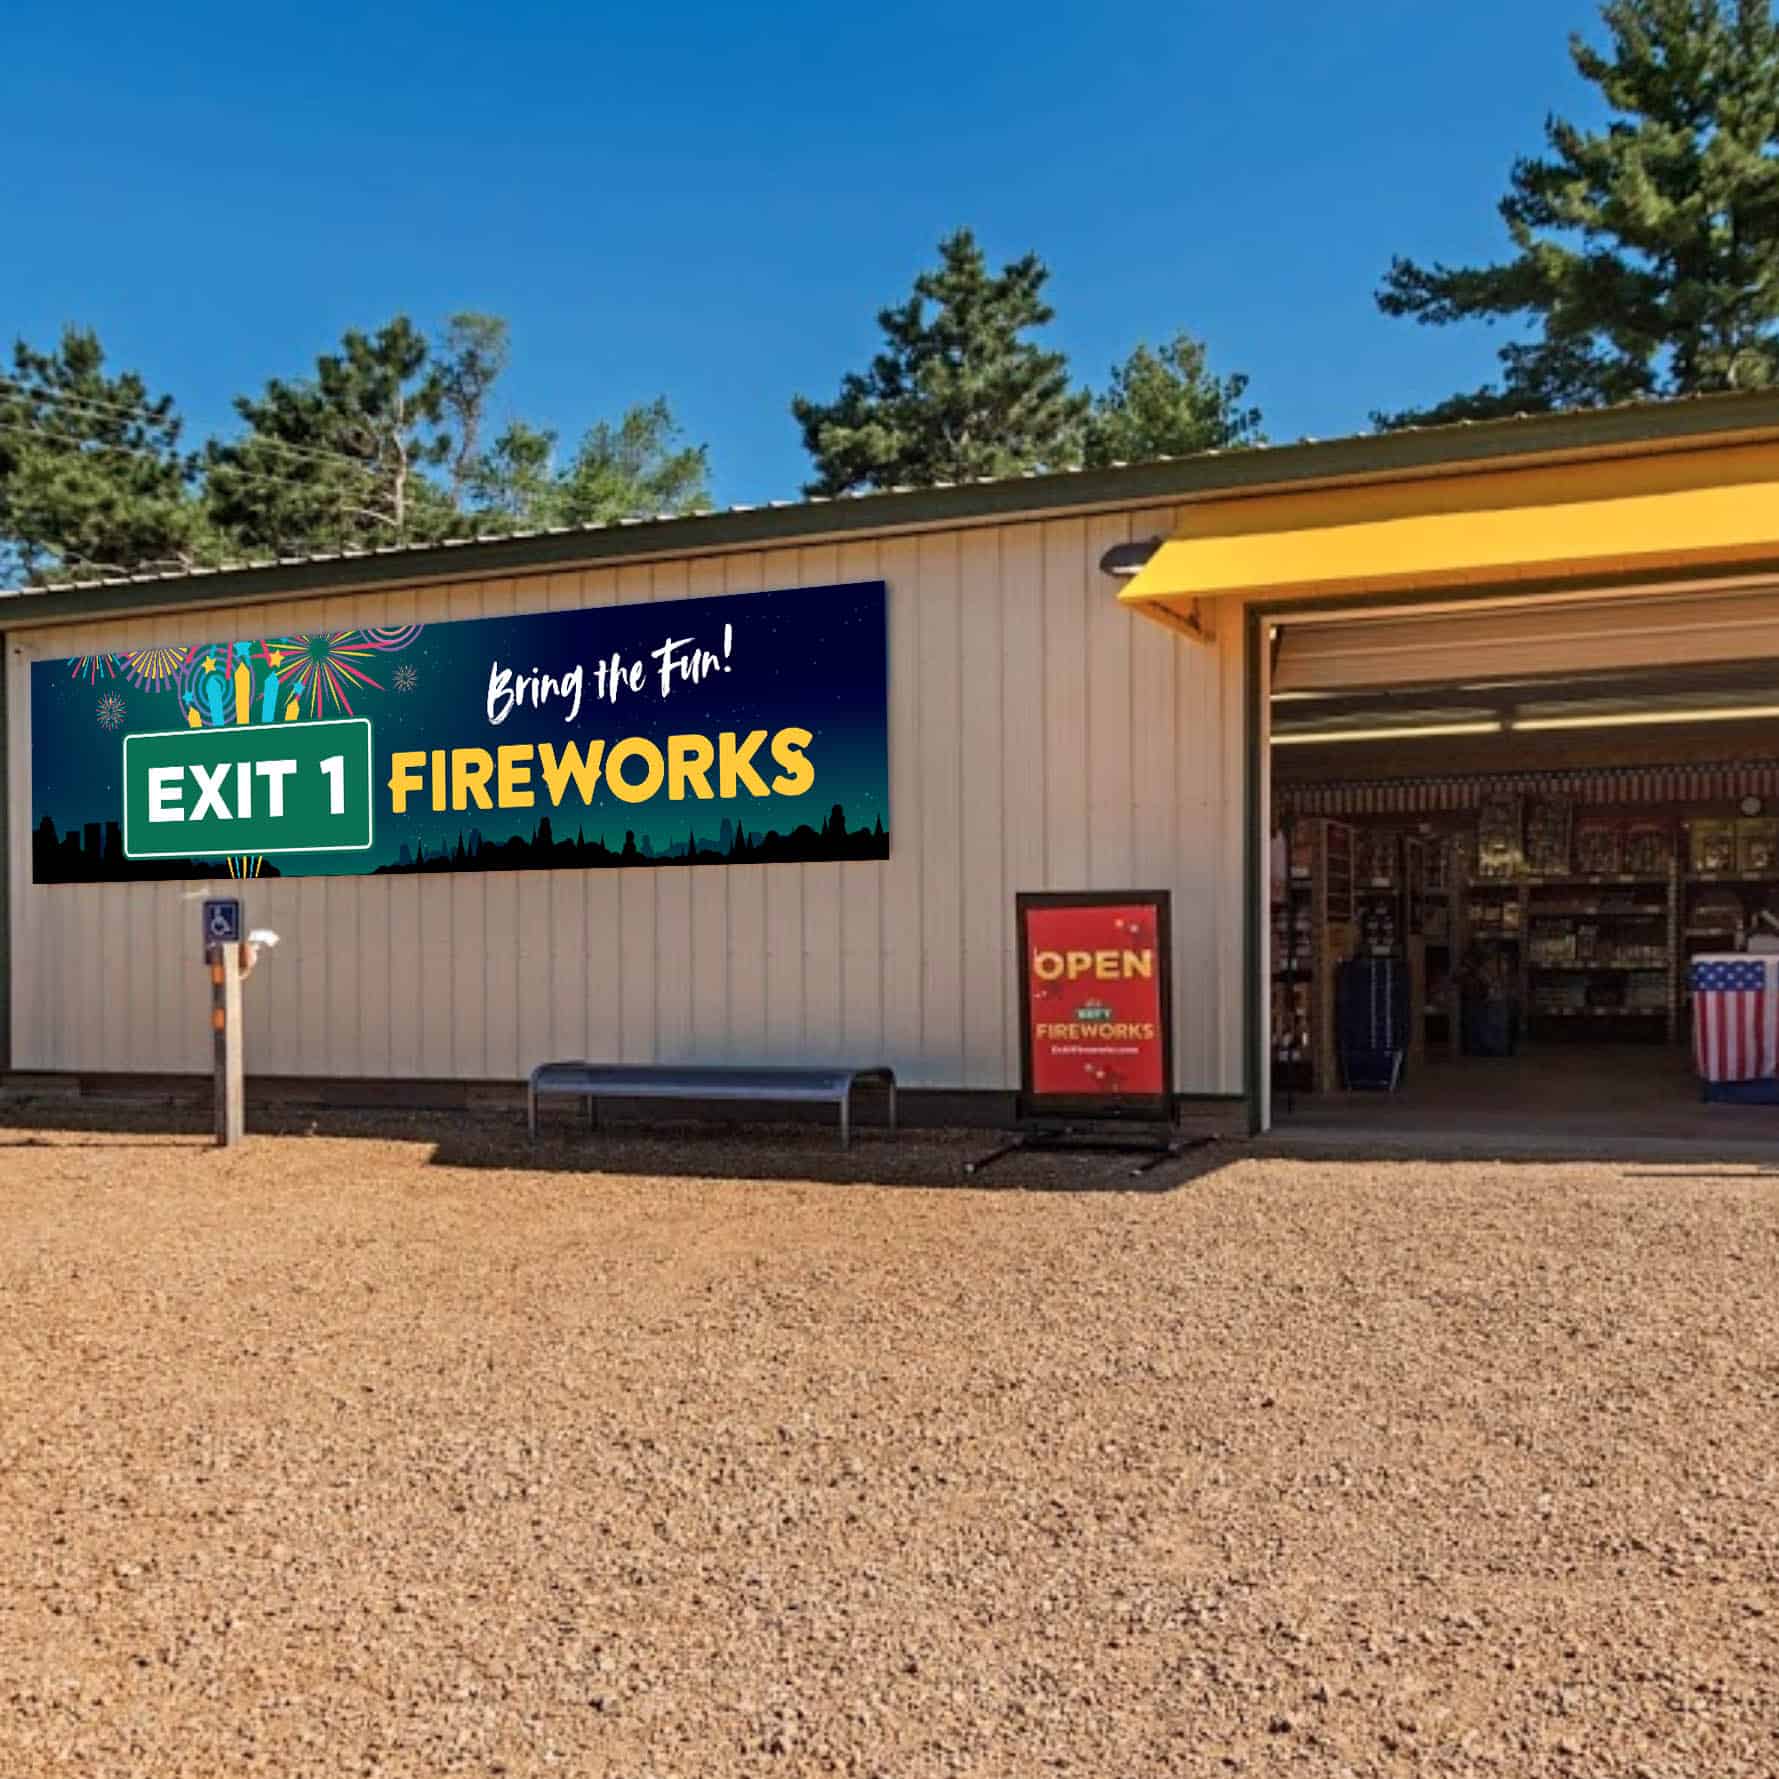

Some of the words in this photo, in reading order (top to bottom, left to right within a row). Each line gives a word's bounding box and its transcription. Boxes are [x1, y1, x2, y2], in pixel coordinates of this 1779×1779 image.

[487, 661, 583, 725] Bring
[594, 652, 646, 703] the
[652, 624, 732, 698] Fun!
[149, 760, 297, 823] EXIT
[320, 756, 345, 815] 1
[389, 728, 815, 813] FIREWORKS
[1034, 950, 1152, 979] OPEN
[1036, 1023, 1154, 1040] FIREWORKS
